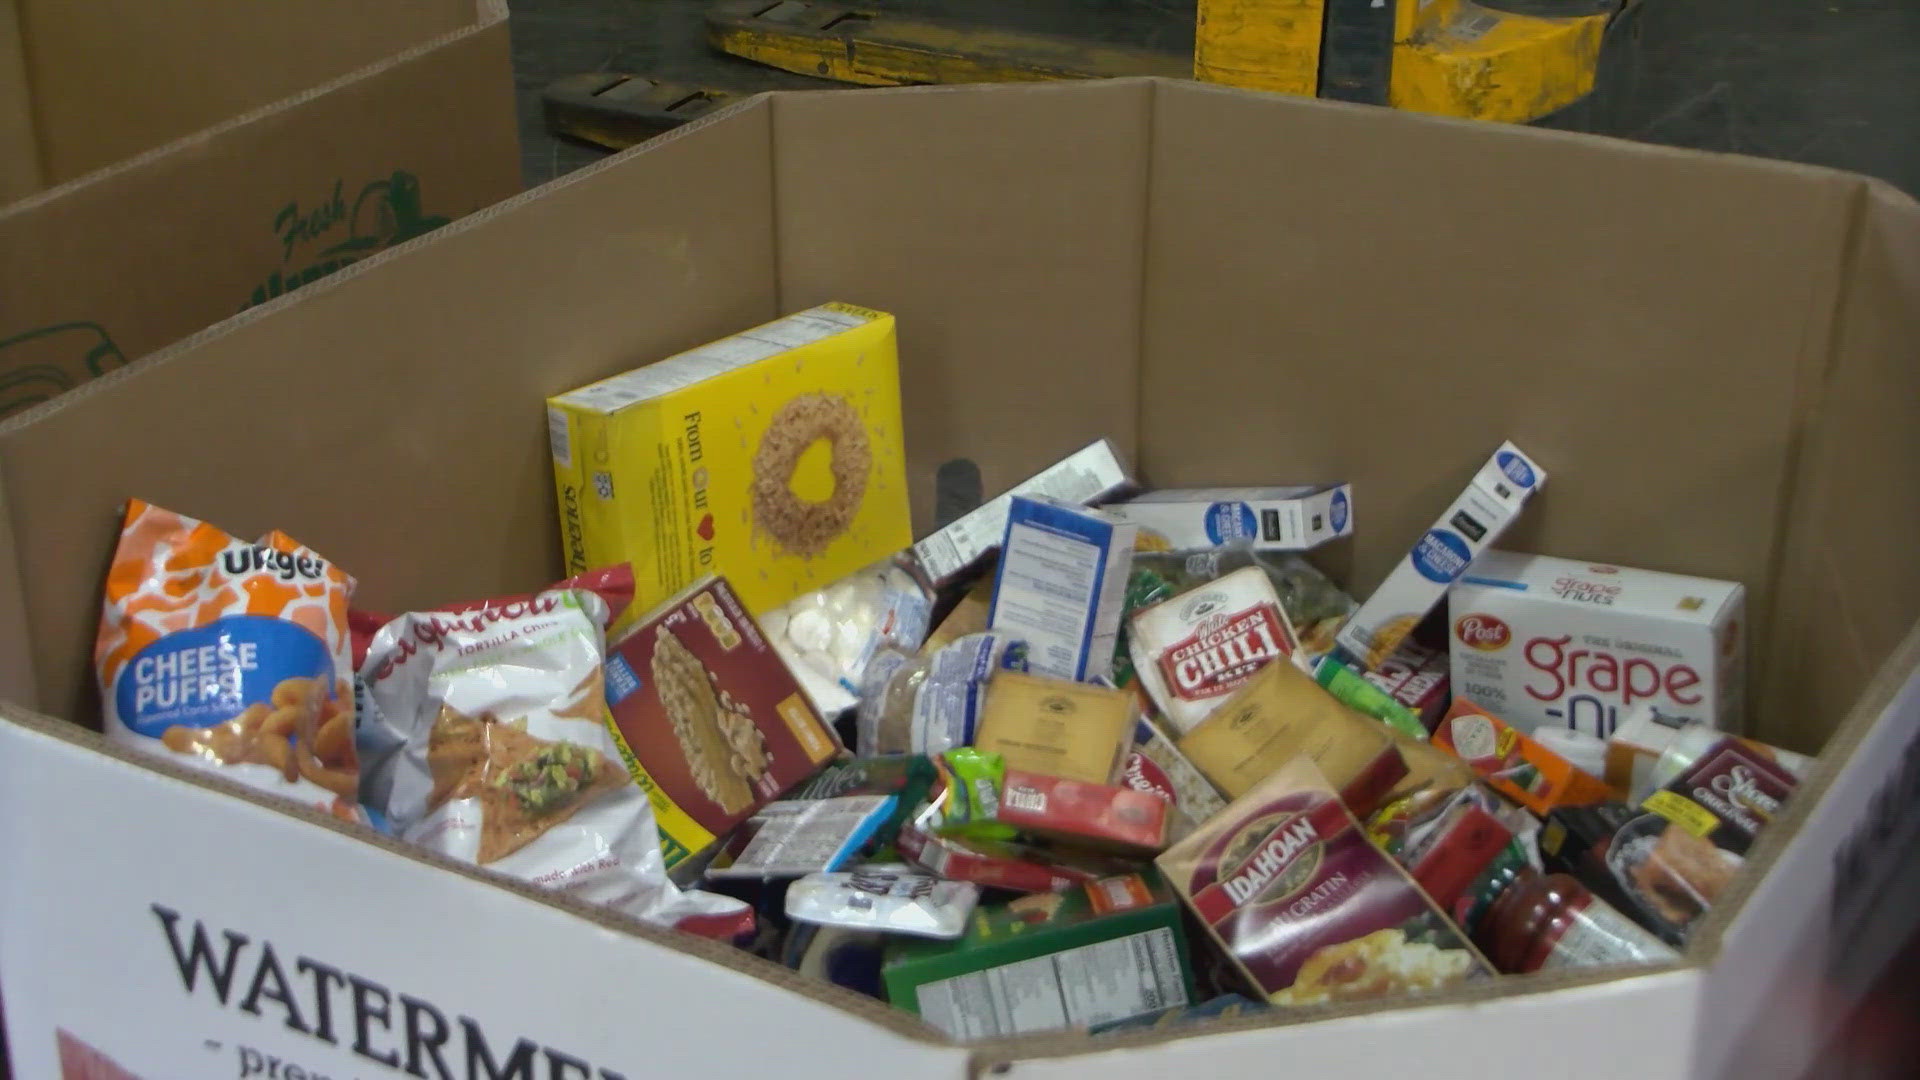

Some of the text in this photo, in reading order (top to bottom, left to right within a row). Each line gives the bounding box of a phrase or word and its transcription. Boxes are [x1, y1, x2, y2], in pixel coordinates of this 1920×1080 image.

[684, 410, 705, 463] From
[699, 546, 714, 567] to
[563, 484, 588, 574] heerios
[1553, 576, 1622, 598] grape
[1170, 610, 1267, 661] CHICKEN
[1175, 620, 1280, 688] CHILI
[1463, 617, 1505, 642] Post
[135, 643, 258, 685] CHEESE
[135, 670, 244, 714] PUFFS
[1523, 633, 1704, 706] grape
[1223, 816, 1319, 906] IDAHOAN
[1289, 870, 1348, 921] GRATIN
[150, 902, 630, 1080] WATERM
